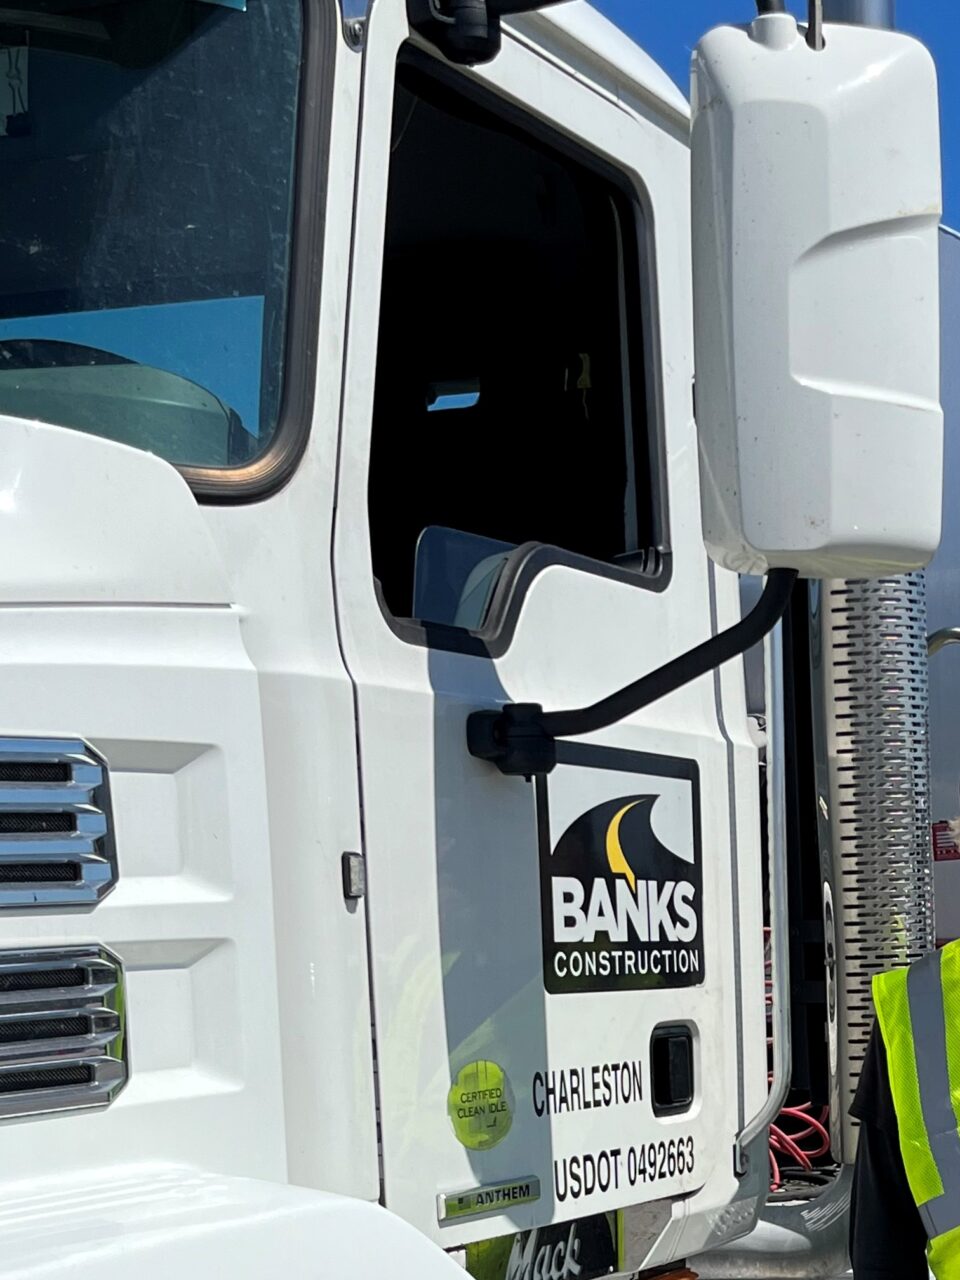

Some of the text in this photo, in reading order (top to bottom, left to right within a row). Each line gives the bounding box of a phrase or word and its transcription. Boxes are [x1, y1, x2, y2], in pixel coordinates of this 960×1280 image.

[551, 876, 697, 943] BANKS
[554, 949, 699, 978] CONSTRUCTION
[460, 1088, 502, 1104] CERTIFIED
[532, 1060, 643, 1117] CHARLESTON
[457, 1101, 507, 1119] CLEAN IDLE
[554, 1136, 695, 1202] USDOT 0492663
[475, 1184, 531, 1207] ANTHEM
